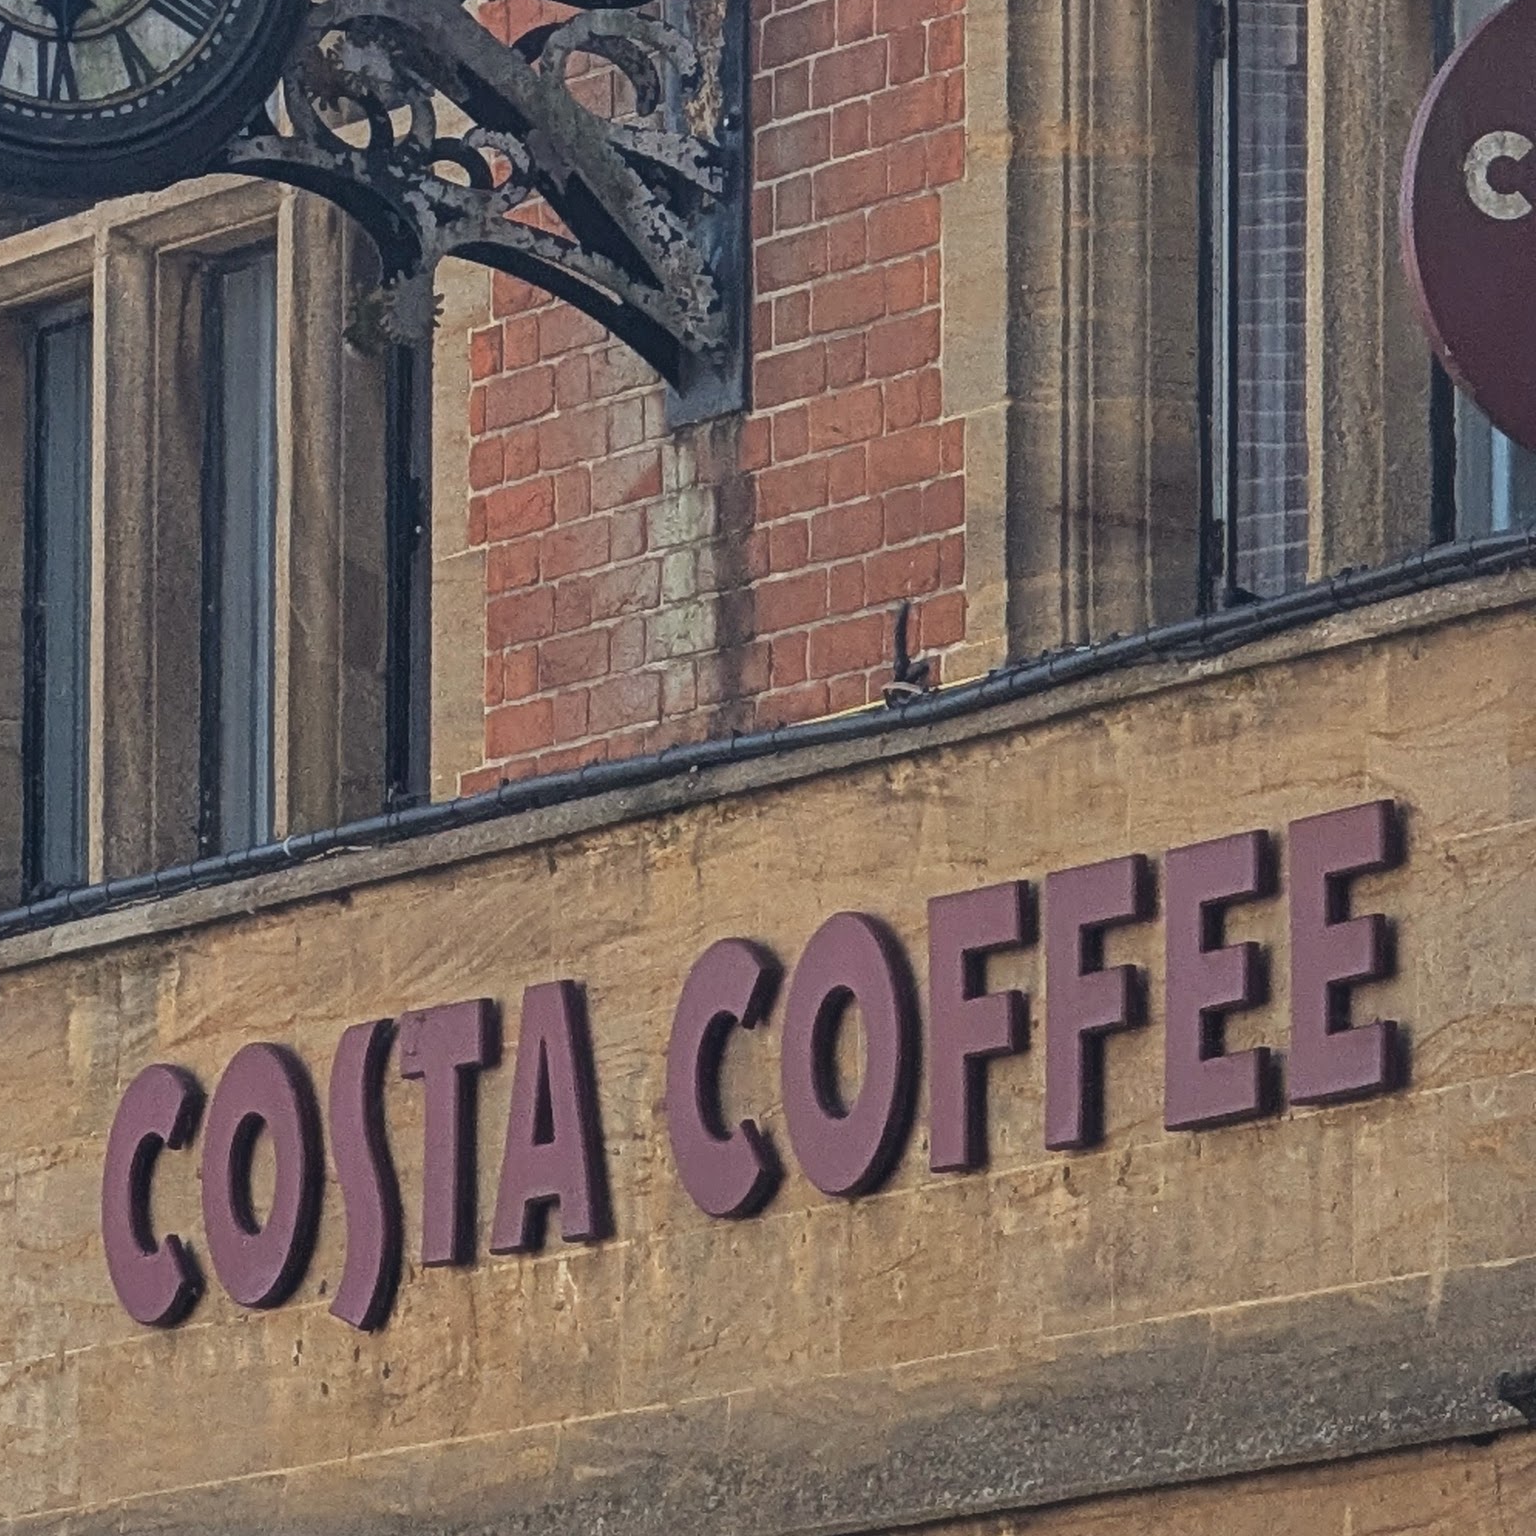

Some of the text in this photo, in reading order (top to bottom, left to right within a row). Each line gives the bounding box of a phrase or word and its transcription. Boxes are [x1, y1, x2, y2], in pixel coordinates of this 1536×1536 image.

[37, 38, 80, 102] VI
[114, 26, 163, 87] V
[101, 798, 1400, 1331] COSTA COFFEE
